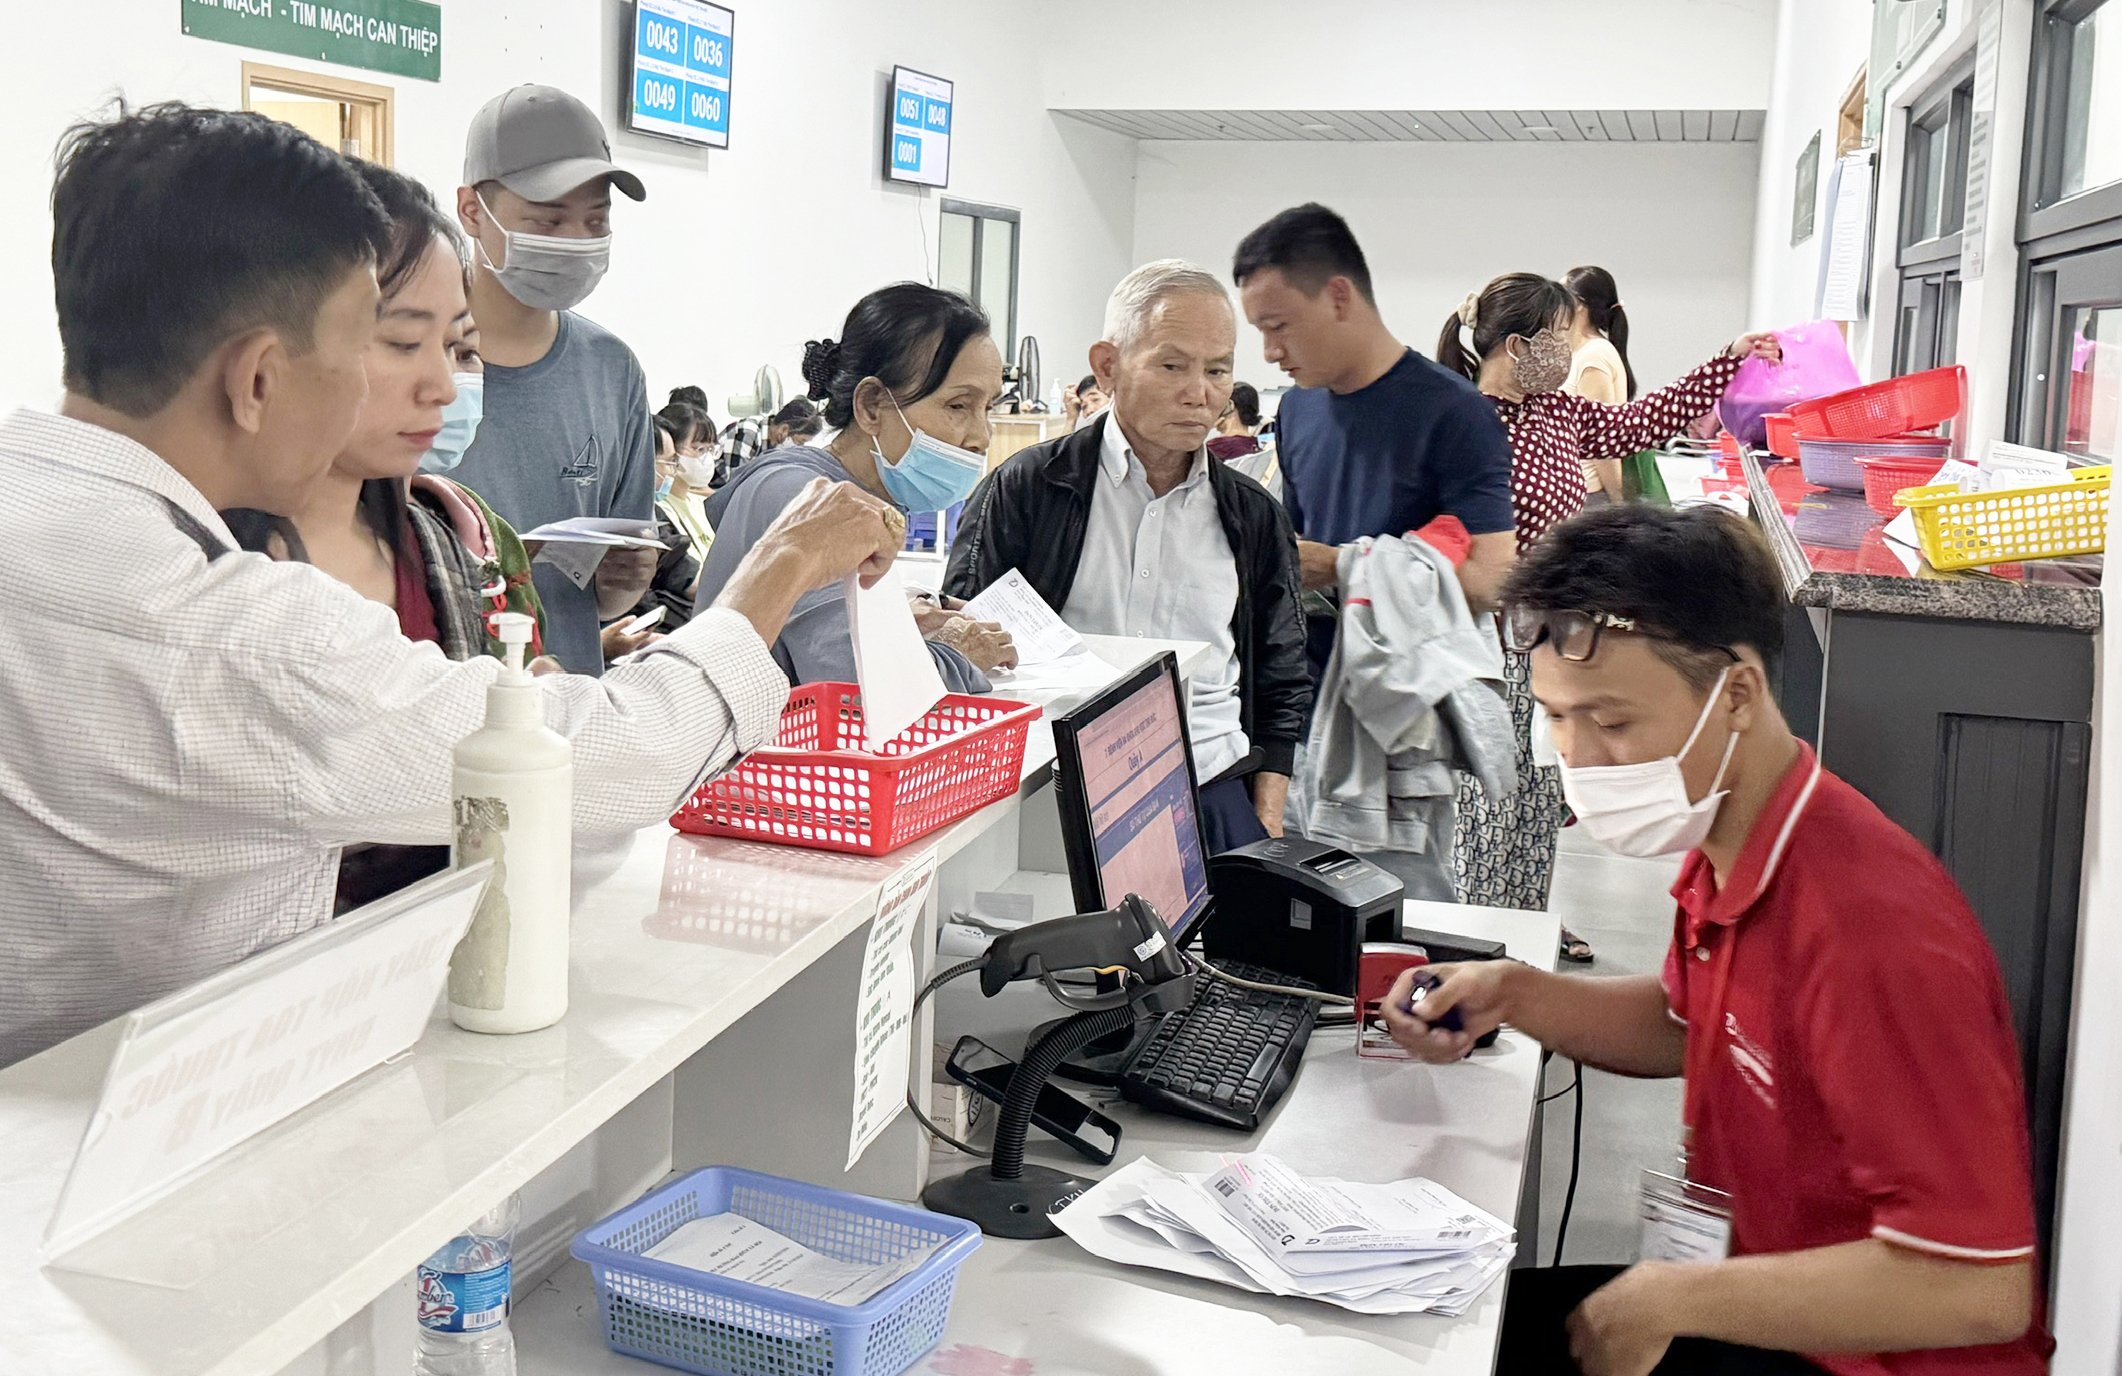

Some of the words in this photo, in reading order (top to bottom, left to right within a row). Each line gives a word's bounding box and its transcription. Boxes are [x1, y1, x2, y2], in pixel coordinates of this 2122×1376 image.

[289, 0, 317, 28] TIM
[320, 7, 364, 39] MẠCH
[367, 17, 397, 46] CAN
[400, 25, 439, 57] THIỆP
[646, 20, 679, 55] 0043
[693, 35, 723, 68] 0036
[644, 79, 676, 112] 0049
[691, 92, 721, 122] 0060
[900, 97, 920, 121] 0051
[897, 141, 917, 165] 0001
